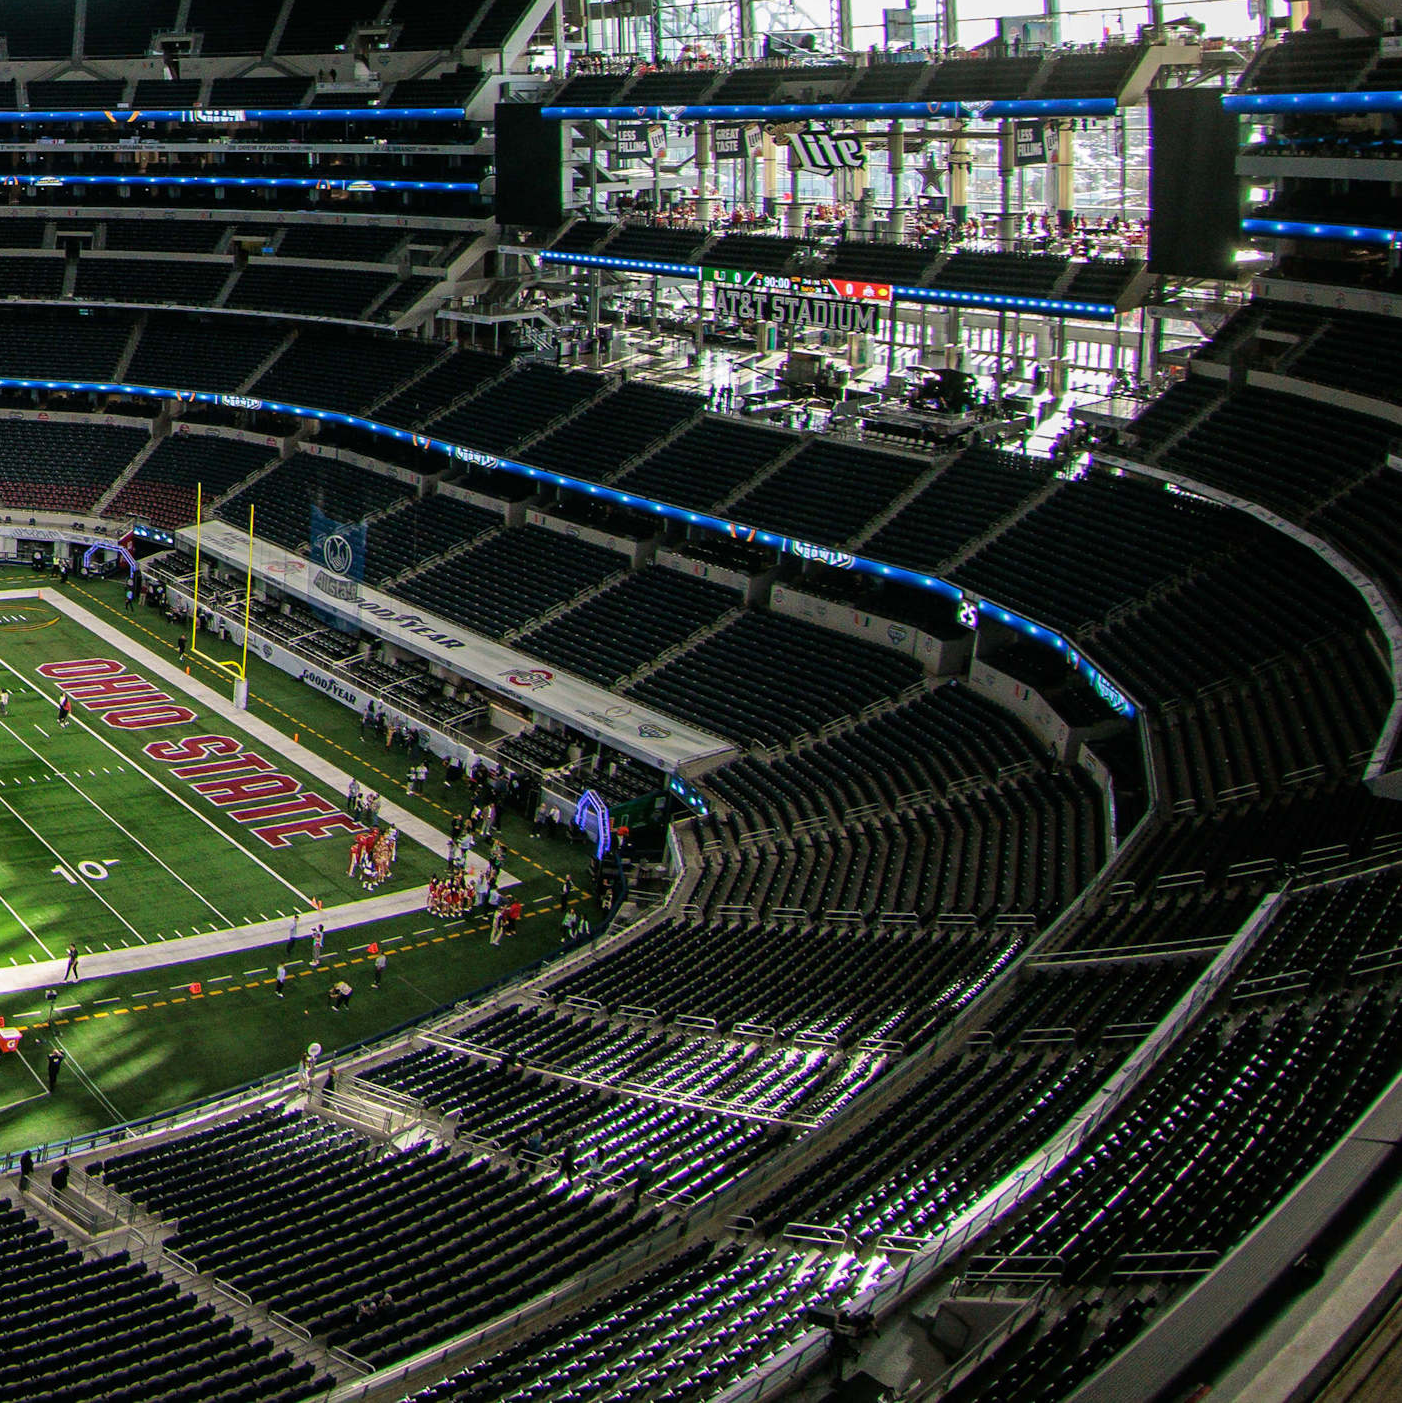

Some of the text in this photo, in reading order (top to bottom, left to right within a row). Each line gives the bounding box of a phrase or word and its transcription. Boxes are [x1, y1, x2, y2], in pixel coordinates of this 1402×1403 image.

[618, 130, 636, 141] LESS
[715, 128, 739, 140] GREAT
[1017, 128, 1034, 142] LESS
[618, 142, 647, 153] FILLING
[715, 140, 740, 152] TASTE
[1017, 142, 1043, 157] FILLING
[784, 133, 865, 176] Lite
[734, 272, 742, 284] 0
[763, 276, 790, 289] 90:00
[846, 283, 854, 295] 0
[714, 289, 876, 334] AT&T STADIUM
[314, 571, 359, 601] Allstate
[960, 602, 978, 626] 25
[303, 669, 357, 705] GOODYEAR
[35, 657, 370, 849] OHIO STATE
[50, 859, 111, 884] 10
